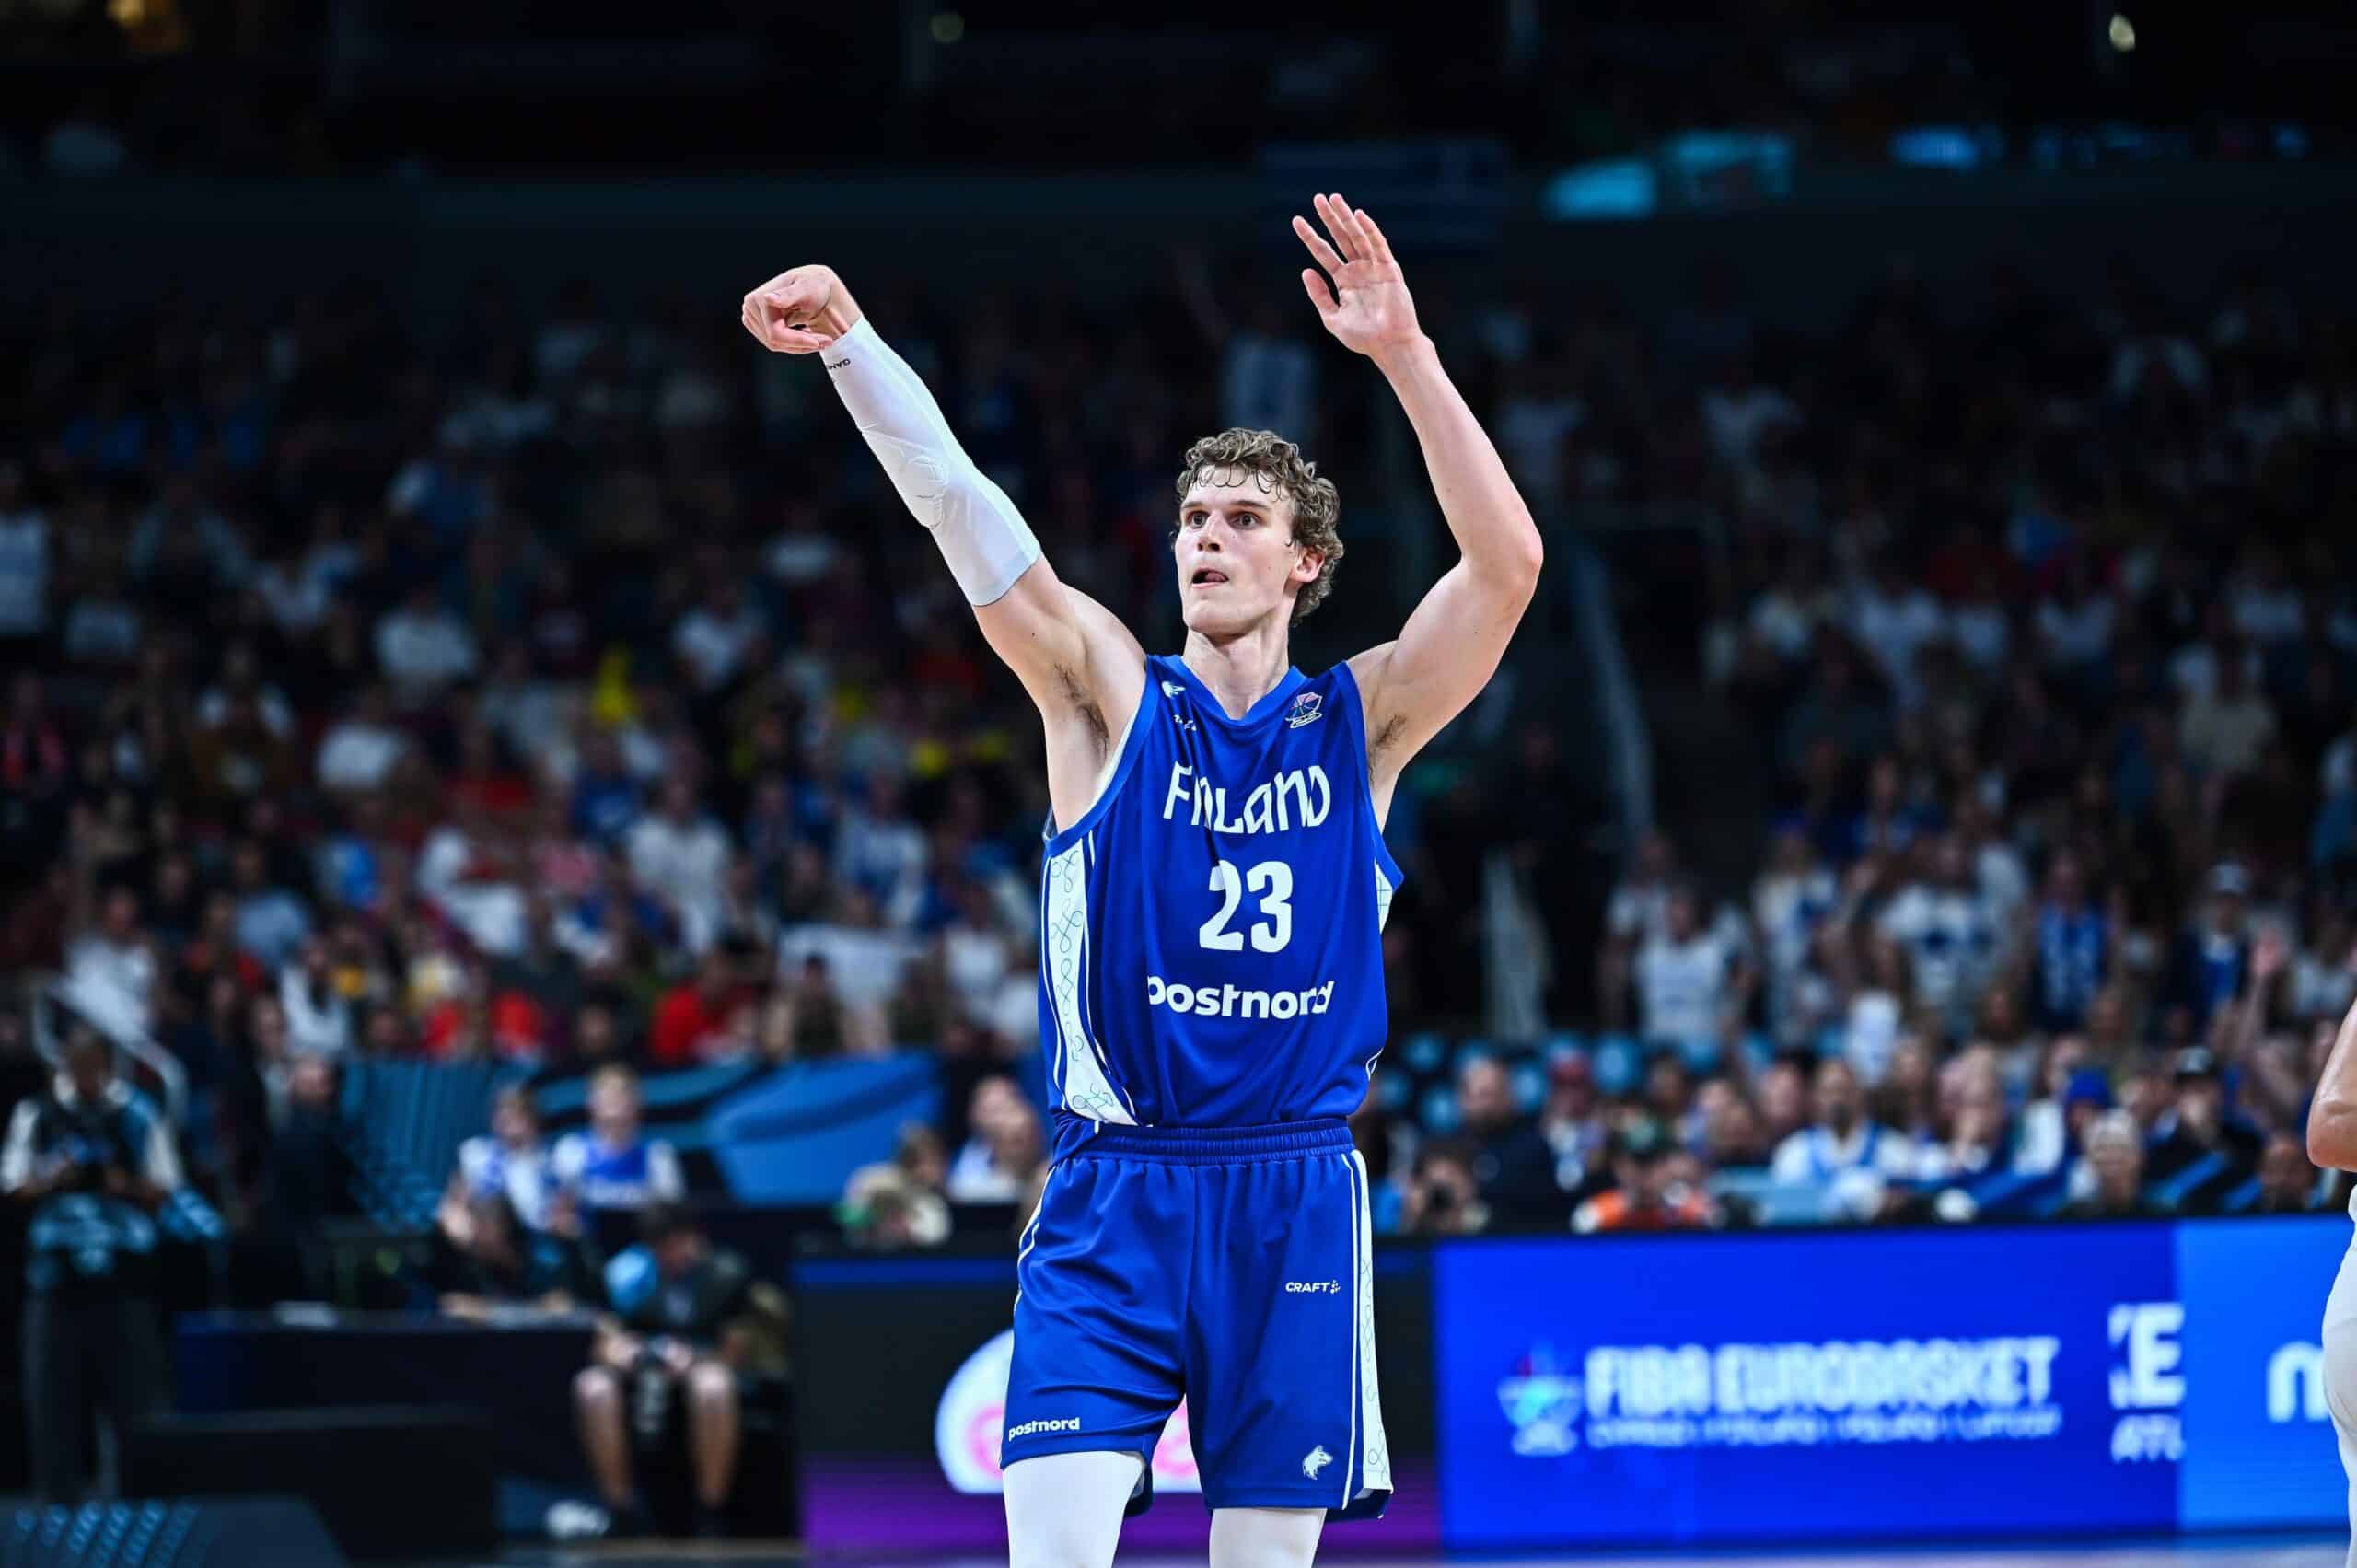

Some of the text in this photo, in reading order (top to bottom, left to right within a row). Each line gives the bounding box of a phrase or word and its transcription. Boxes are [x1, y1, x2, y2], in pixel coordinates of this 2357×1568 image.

[1199, 859, 1294, 953] 23
[1285, 1282, 1330, 1293] CRAFT
[1008, 1417, 1081, 1442] postnord
